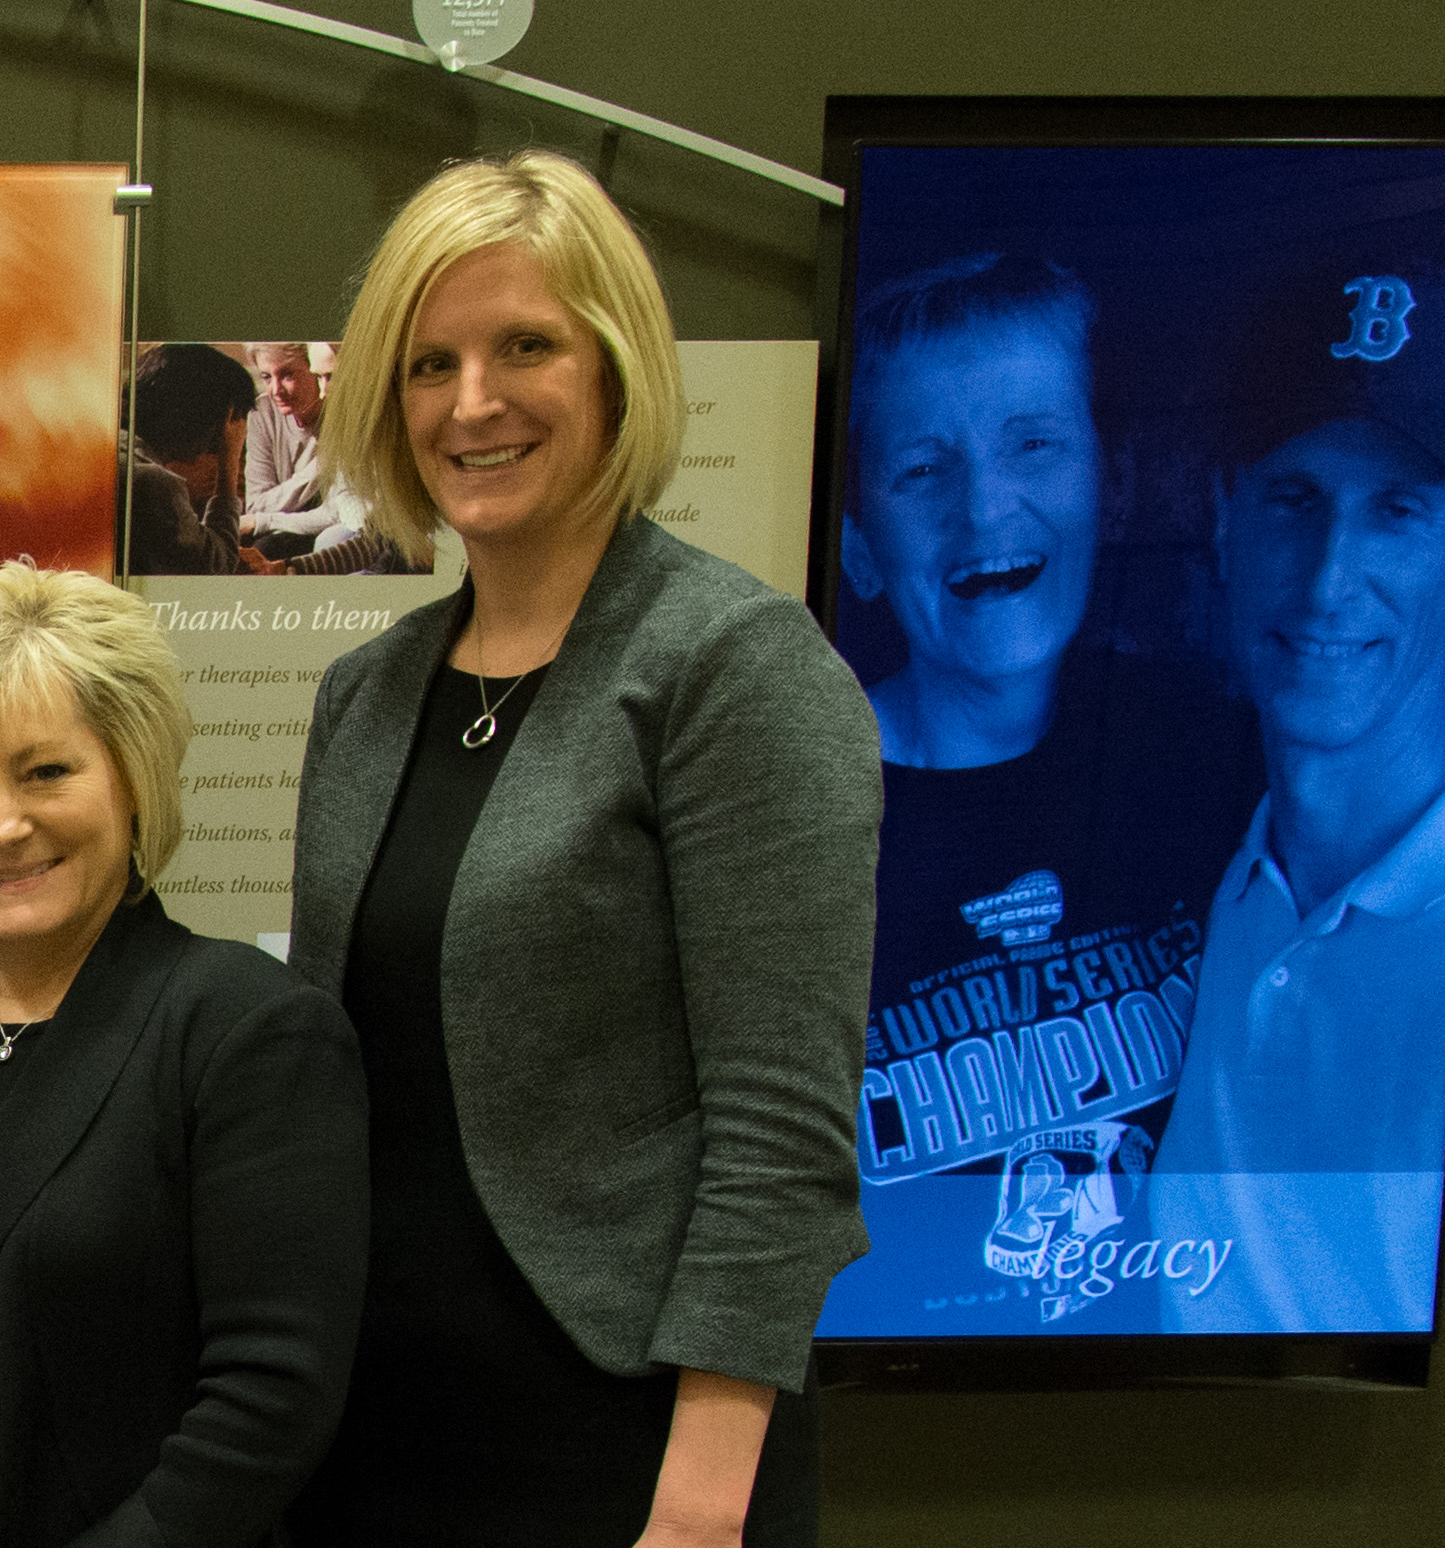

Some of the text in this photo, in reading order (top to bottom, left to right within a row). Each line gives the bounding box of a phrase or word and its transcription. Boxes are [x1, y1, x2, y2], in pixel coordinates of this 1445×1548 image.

[1330, 275, 1417, 362] B
[686, 401, 718, 415] cer
[681, 453, 736, 469] omen
[149, 600, 262, 631] Thanks
[271, 604, 302, 631] to
[199, 665, 291, 687] therapies
[191, 718, 310, 742] senting criti
[192, 771, 273, 794] patients
[184, 823, 272, 843] ibutions,
[154, 875, 293, 894] untless thousa
[881, 964, 1039, 1054] WORLD
[1042, 917, 1203, 1014] SERIES
[860, 954, 1202, 1169] CHAMPIO
[1035, 1129, 1098, 1150] SERIES
[1030, 1219, 1234, 1298] legacy
